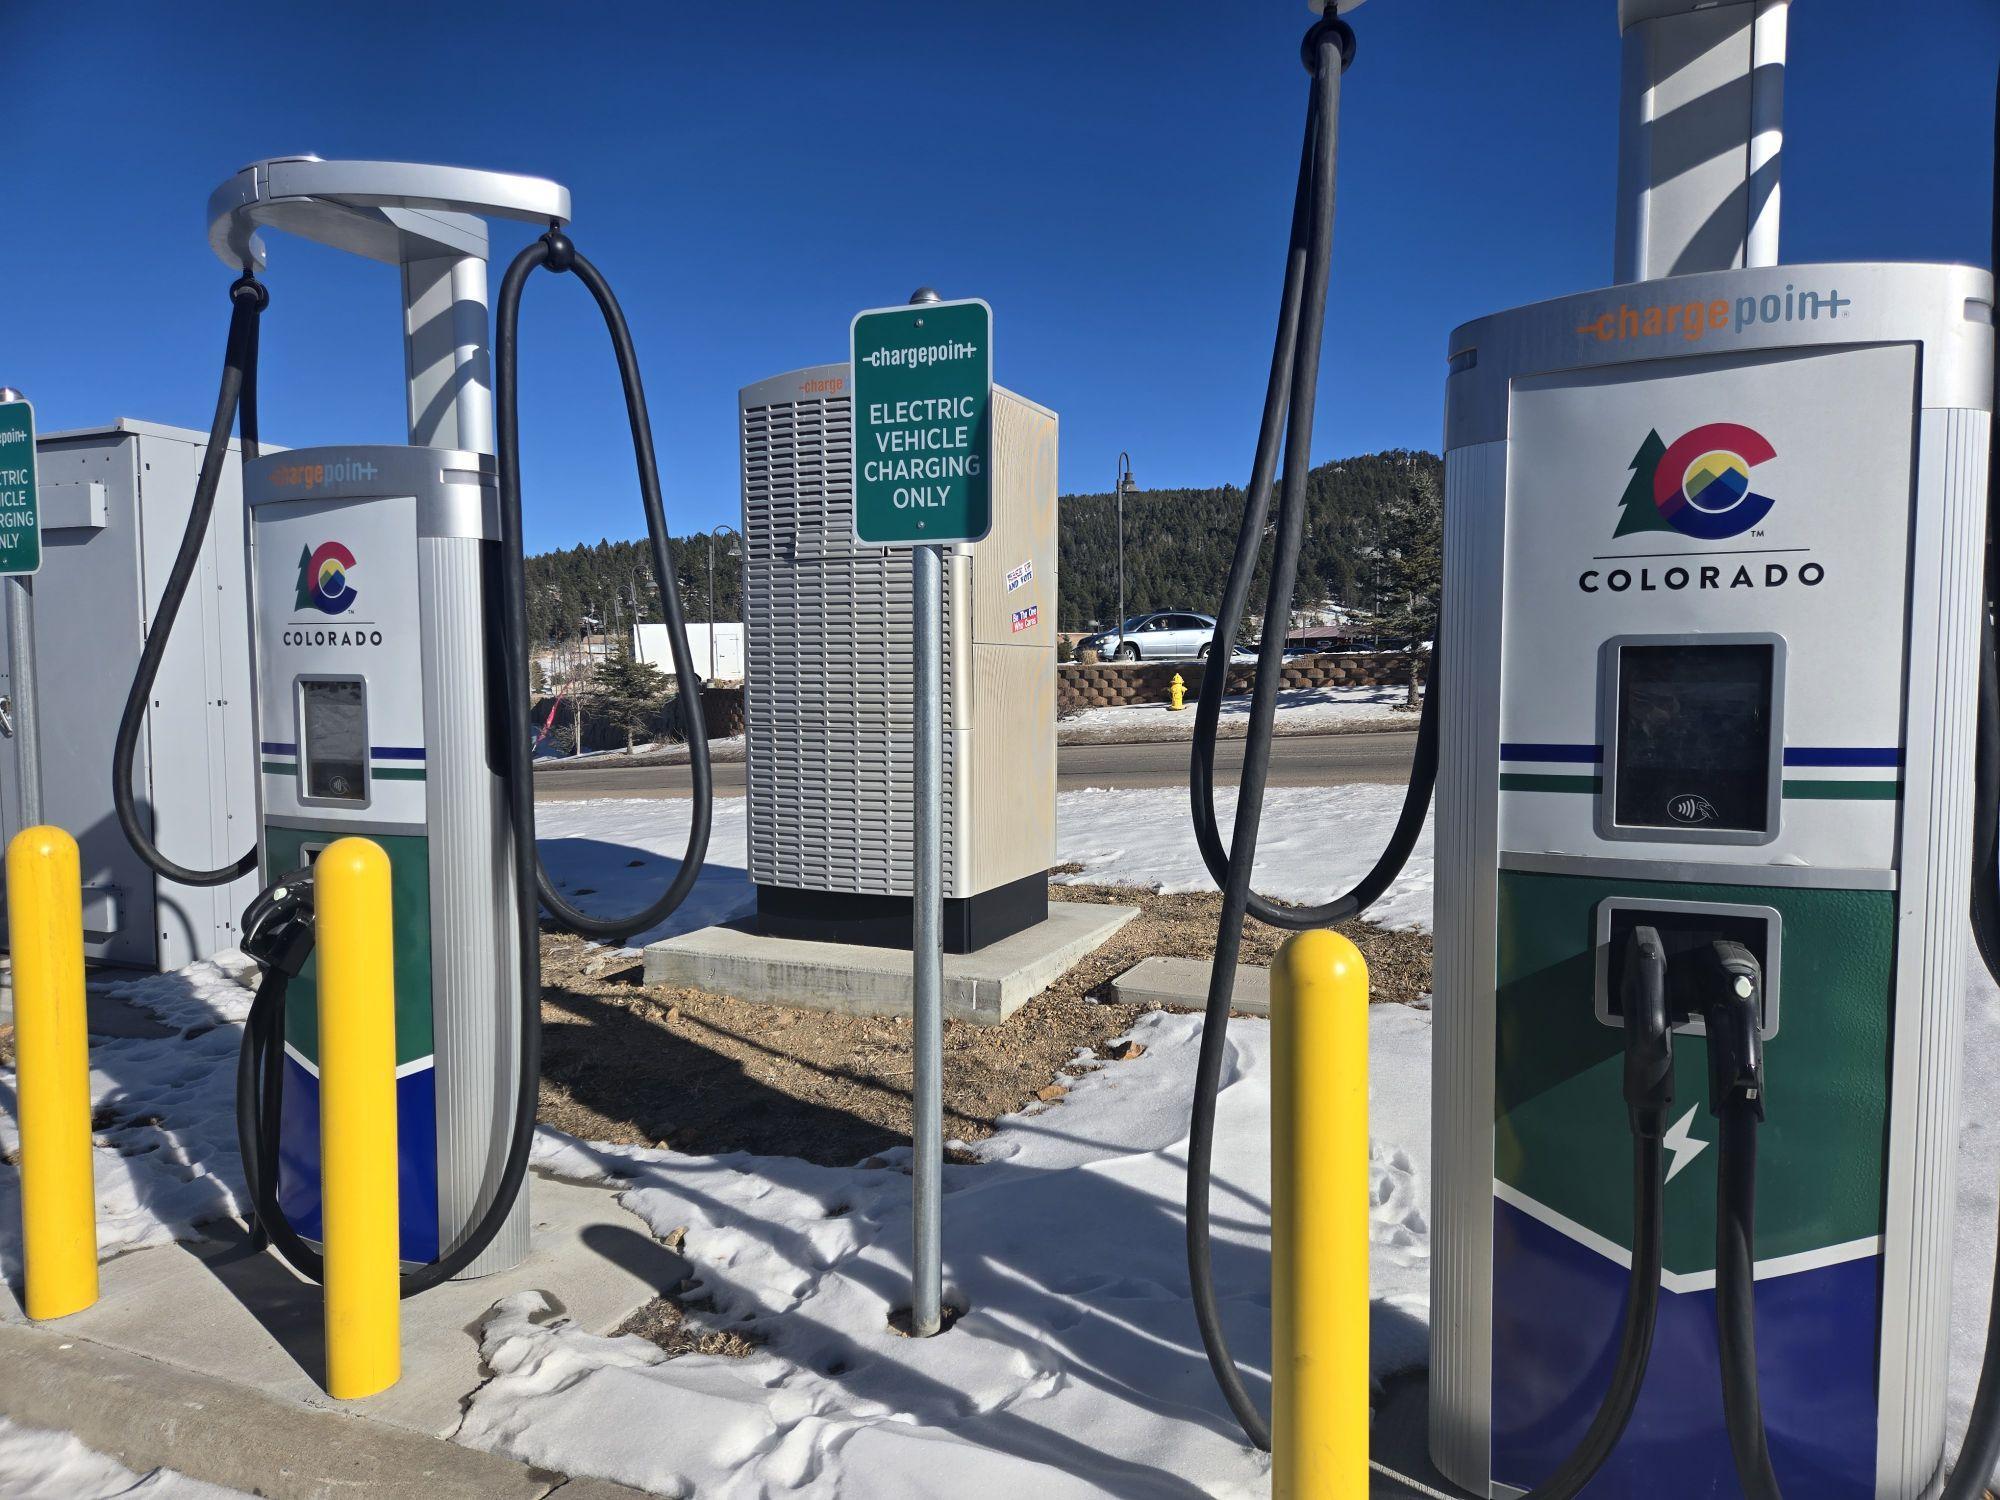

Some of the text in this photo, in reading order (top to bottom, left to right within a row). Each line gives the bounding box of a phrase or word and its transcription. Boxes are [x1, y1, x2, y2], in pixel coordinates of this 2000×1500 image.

[870, 396, 974, 425] ELECTRIC
[875, 426, 968, 453] VEHICLE
[0, 469, 28, 486] TRIC
[864, 455, 980, 482] CHARGING
[893, 485, 951, 509] ONLY
[1750, 530, 1765, 538] TM
[1579, 562, 1825, 593] COLORADO
[283, 631, 383, 646] COLORADO
